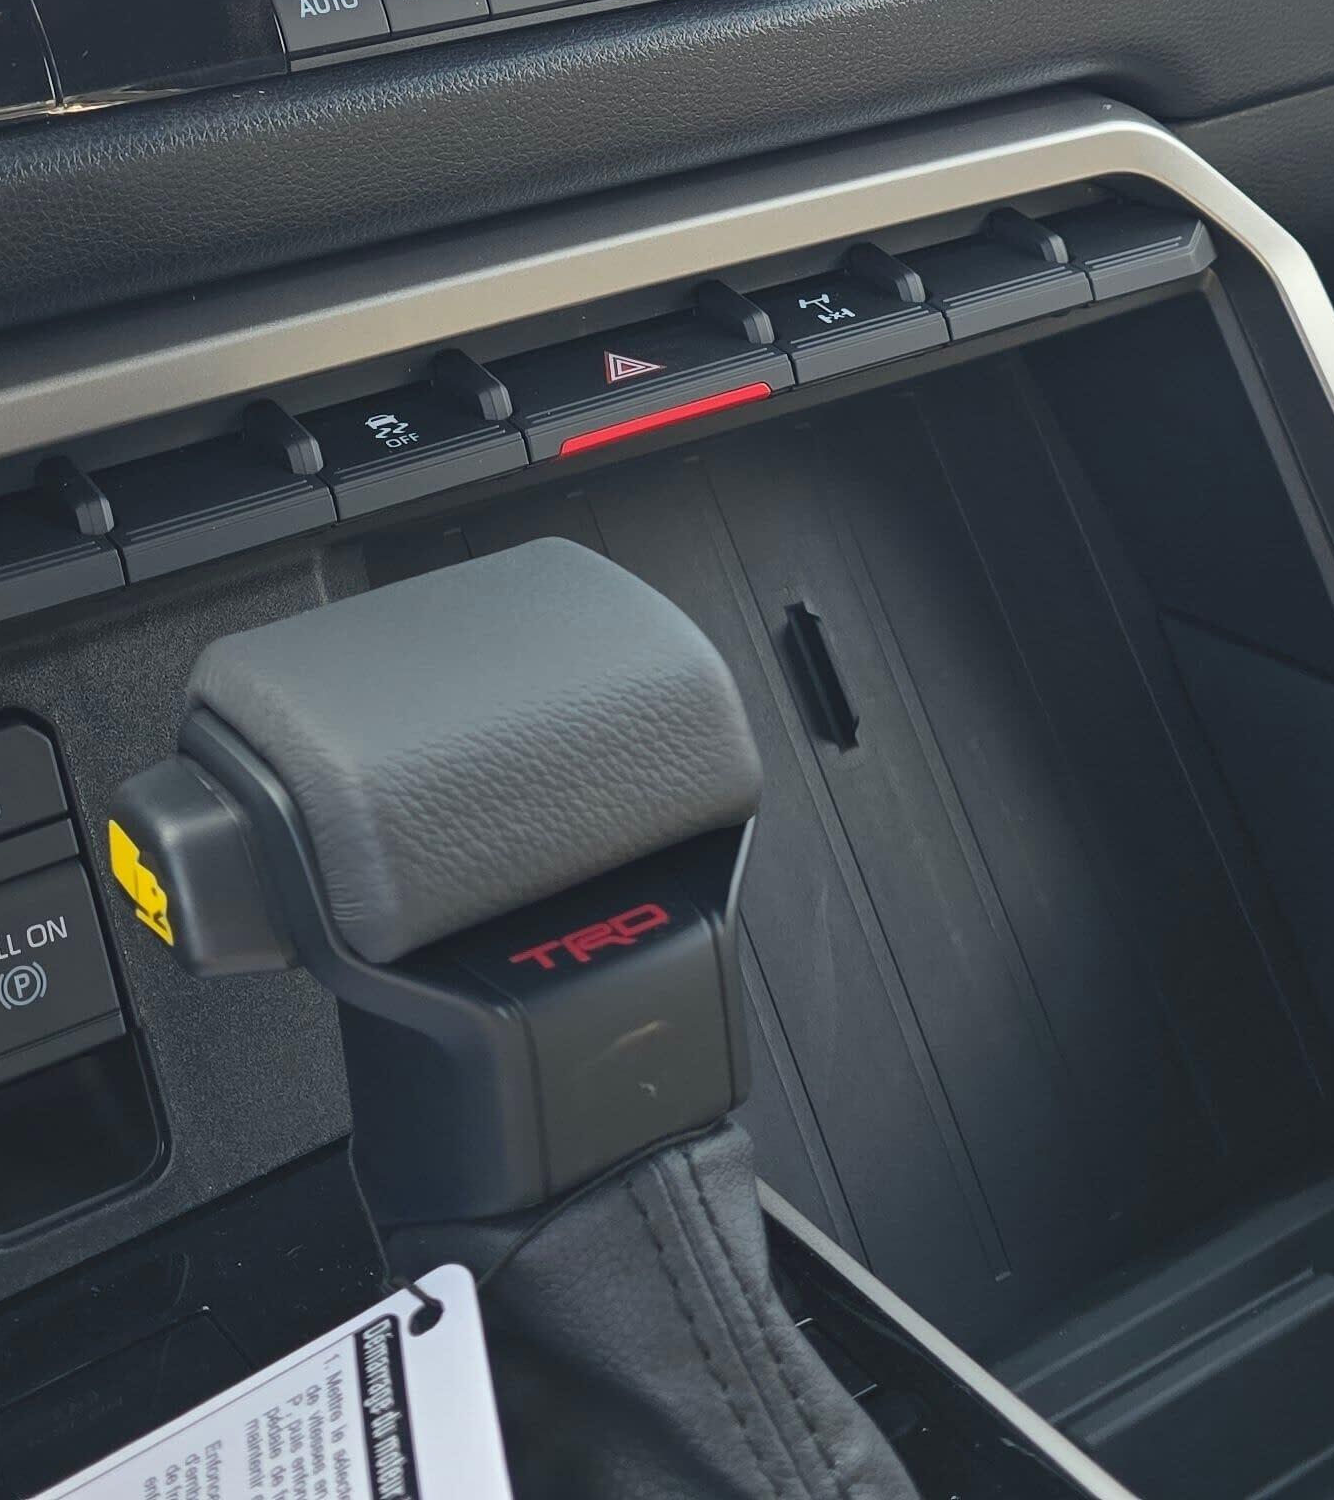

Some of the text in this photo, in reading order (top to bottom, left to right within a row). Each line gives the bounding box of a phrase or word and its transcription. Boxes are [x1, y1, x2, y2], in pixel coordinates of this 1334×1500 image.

[385, 432, 420, 448] OFF
[26, 915, 68, 949] ON
[508, 903, 670, 969] TRD
[305, 1384, 323, 1406] de
[325, 1370, 345, 1423] Mettre
[362, 1319, 409, 1500] Démarrage du moteur
[244, 1417, 265, 1490] maintenir
[308, 1409, 327, 1476] vitesses
[330, 1423, 348, 1444] le
